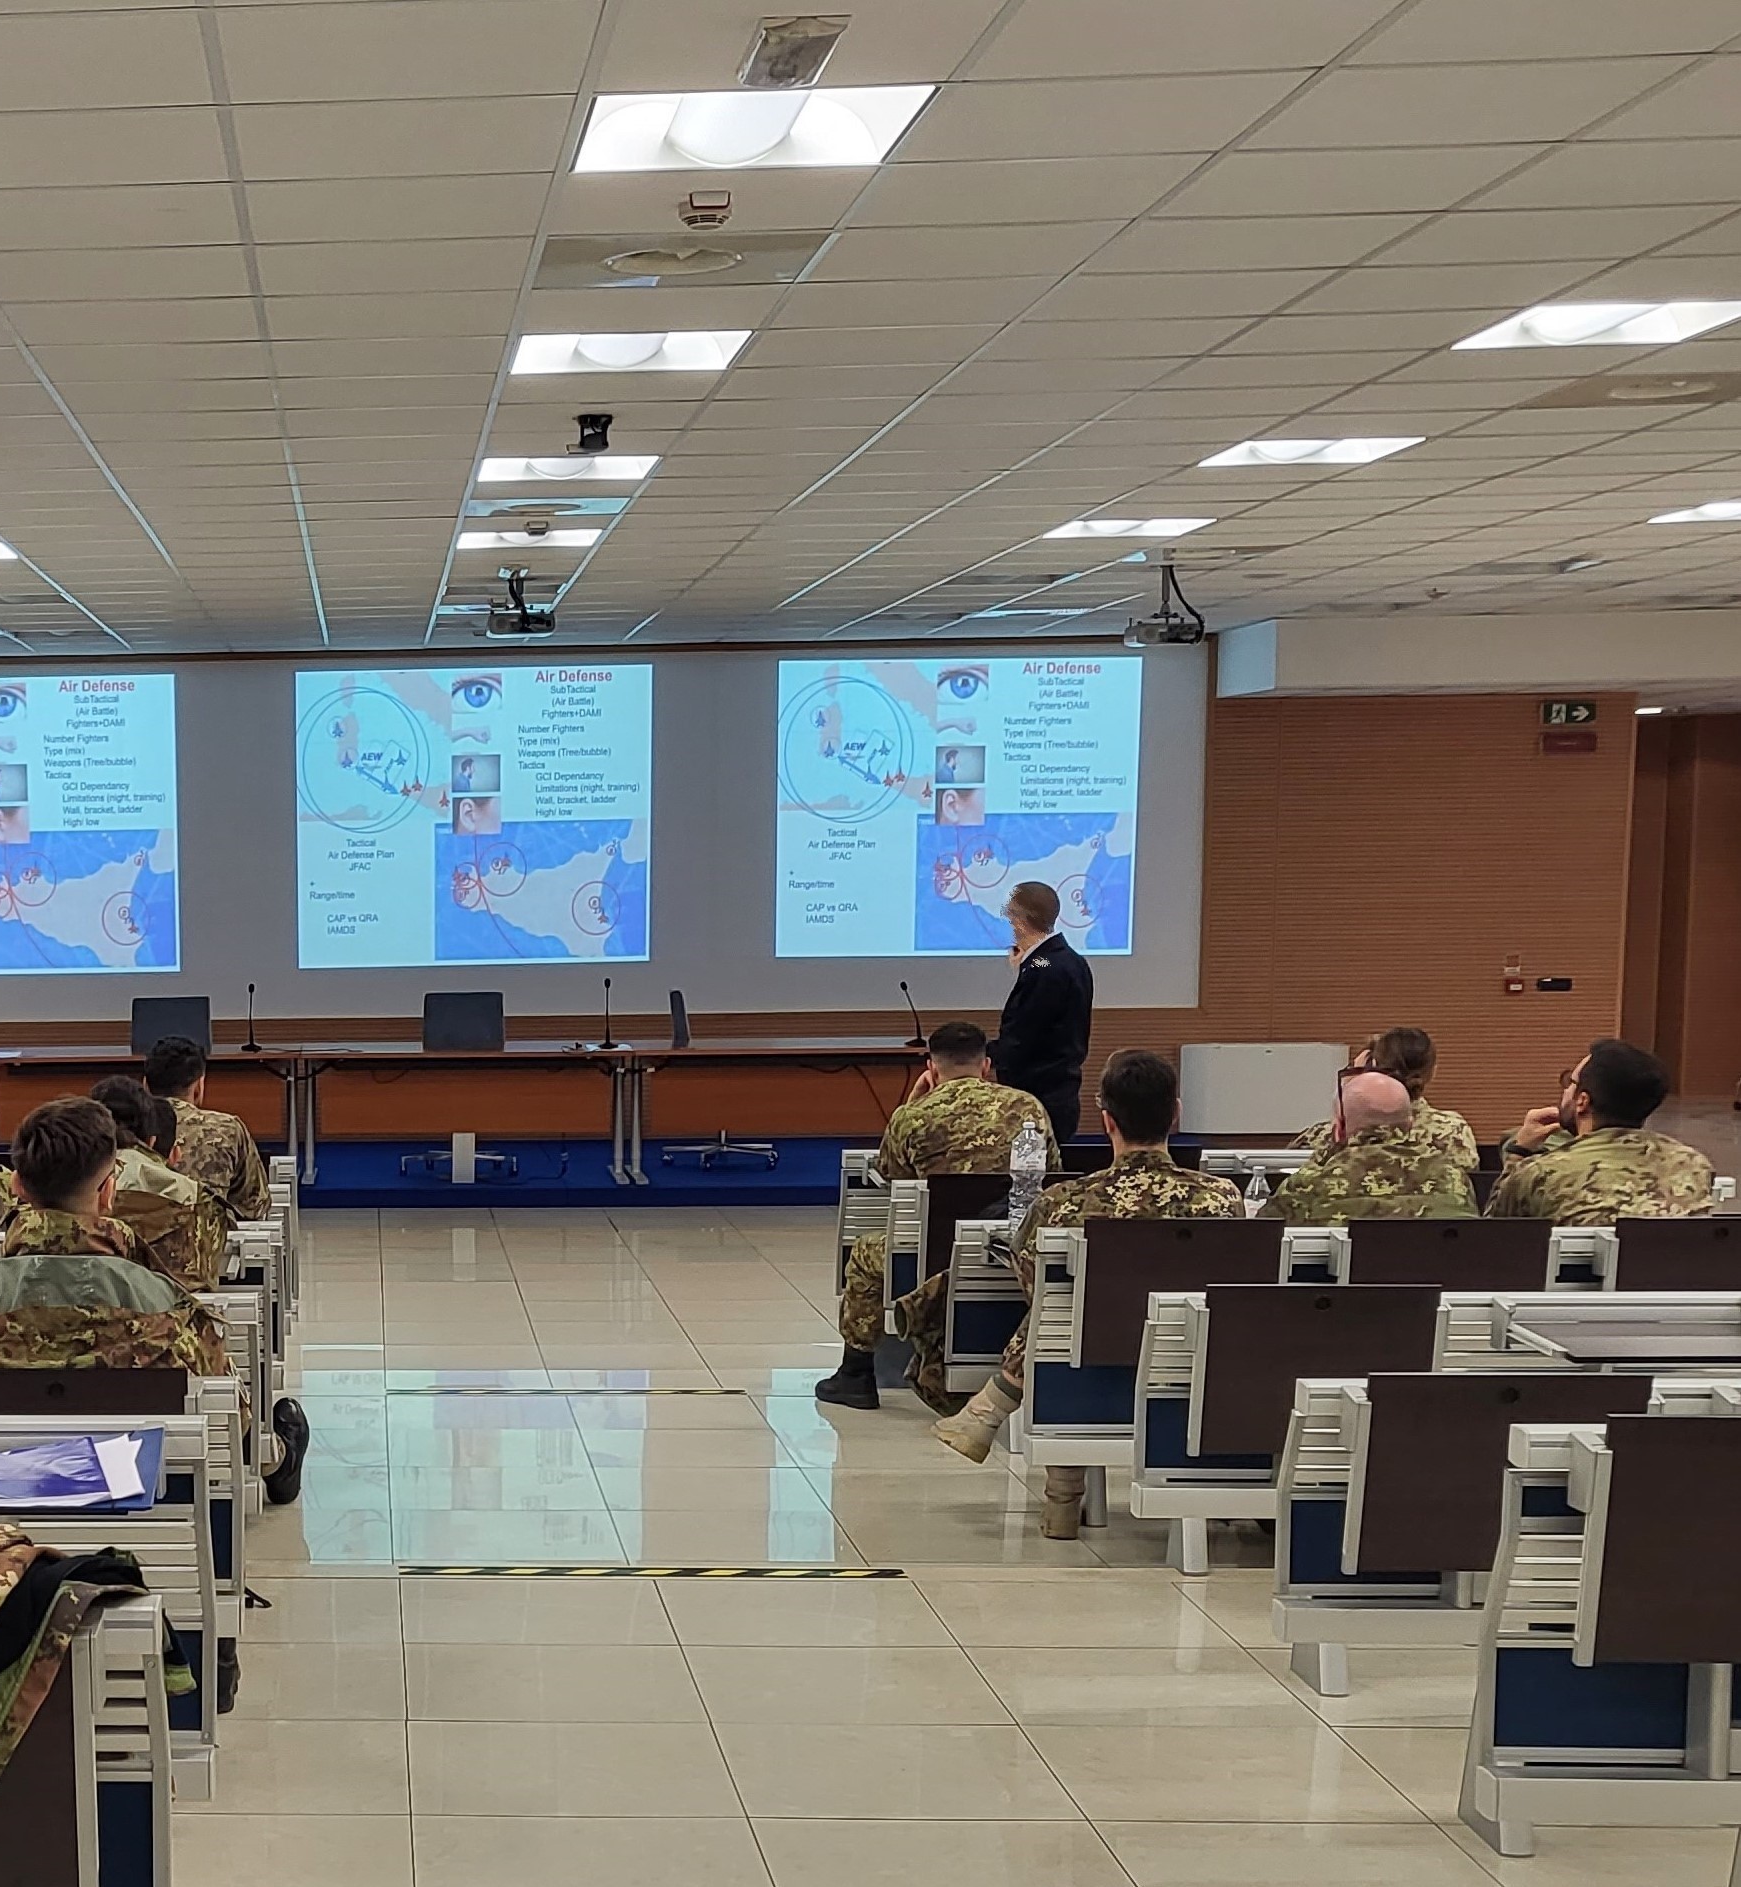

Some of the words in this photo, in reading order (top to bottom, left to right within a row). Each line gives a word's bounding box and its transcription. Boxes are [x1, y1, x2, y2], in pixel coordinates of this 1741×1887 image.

[1023, 662, 1044, 674] Air
[1047, 662, 1101, 674] Defense
[535, 670, 555, 683] Air
[559, 670, 612, 682] Defense
[59, 680, 78, 692] Air
[82, 680, 135, 692] Defense
[1039, 689, 1052, 698] (Air
[1056, 689, 1082, 698] Battle)
[552, 698, 565, 706] (Air
[568, 697, 594, 706] Battle)
[76, 707, 89, 716] (Air
[92, 707, 118, 716] Battle)
[1004, 717, 1036, 725] Number
[1039, 716, 1071, 726] Fighters
[518, 725, 550, 733] Number
[552, 724, 584, 734] Fighters
[1004, 729, 1023, 738] Type
[1026, 728, 1046, 738] (mix)
[44, 735, 74, 743] Number
[77, 734, 109, 744] Fighters
[518, 737, 537, 746] Type
[539, 737, 560, 746] (mix)
[844, 742, 865, 751] AEW
[1004, 741, 1041, 750] Weapons
[44, 747, 62, 756] Type
[65, 746, 85, 755] (mix)
[518, 749, 555, 758] Weapons
[361, 753, 382, 762] AEW
[1004, 753, 1030, 762] Tactics
[44, 759, 81, 768] Weapons
[1021, 765, 1036, 773] GCI
[45, 771, 71, 779] Tactics
[536, 772, 551, 780] GCI
[554, 772, 604, 781] Dependancy
[1021, 777, 1063, 785] Limitations
[1066, 776, 1090, 786] (night,
[1094, 776, 1126, 786] training)
[536, 784, 577, 792] Limitations
[580, 783, 605, 793] (night,
[608, 783, 640, 792] training)
[1020, 788, 1039, 797] Wall,
[1042, 788, 1074, 797] bracket,
[1077, 787, 1102, 796] ladder
[63, 795, 104, 803] Limitations
[107, 794, 131, 803] (night,
[134, 793, 165, 803] training)
[536, 796, 554, 804] Wall,
[557, 795, 589, 804] bracket,
[592, 794, 616, 803] ladder
[1044, 800, 1057, 808] low
[63, 806, 81, 814] Wall,
[84, 805, 115, 814] bracket,
[118, 805, 142, 813] ladder
[559, 808, 572, 816] low
[86, 818, 99, 826] low
[827, 828, 857, 837] Tactical
[346, 839, 376, 847] Tactical
[808, 840, 820, 848] Air
[822, 840, 855, 848] Defense
[858, 840, 876, 848] Plan
[328, 851, 339, 859] Air
[341, 850, 374, 859] Defense
[376, 850, 394, 858] Plan
[349, 862, 371, 871] JFAC
[806, 903, 825, 912] CAP
[327, 914, 346, 922] CAP
[359, 914, 378, 923] QRA
[327, 926, 355, 935] IAMDS
